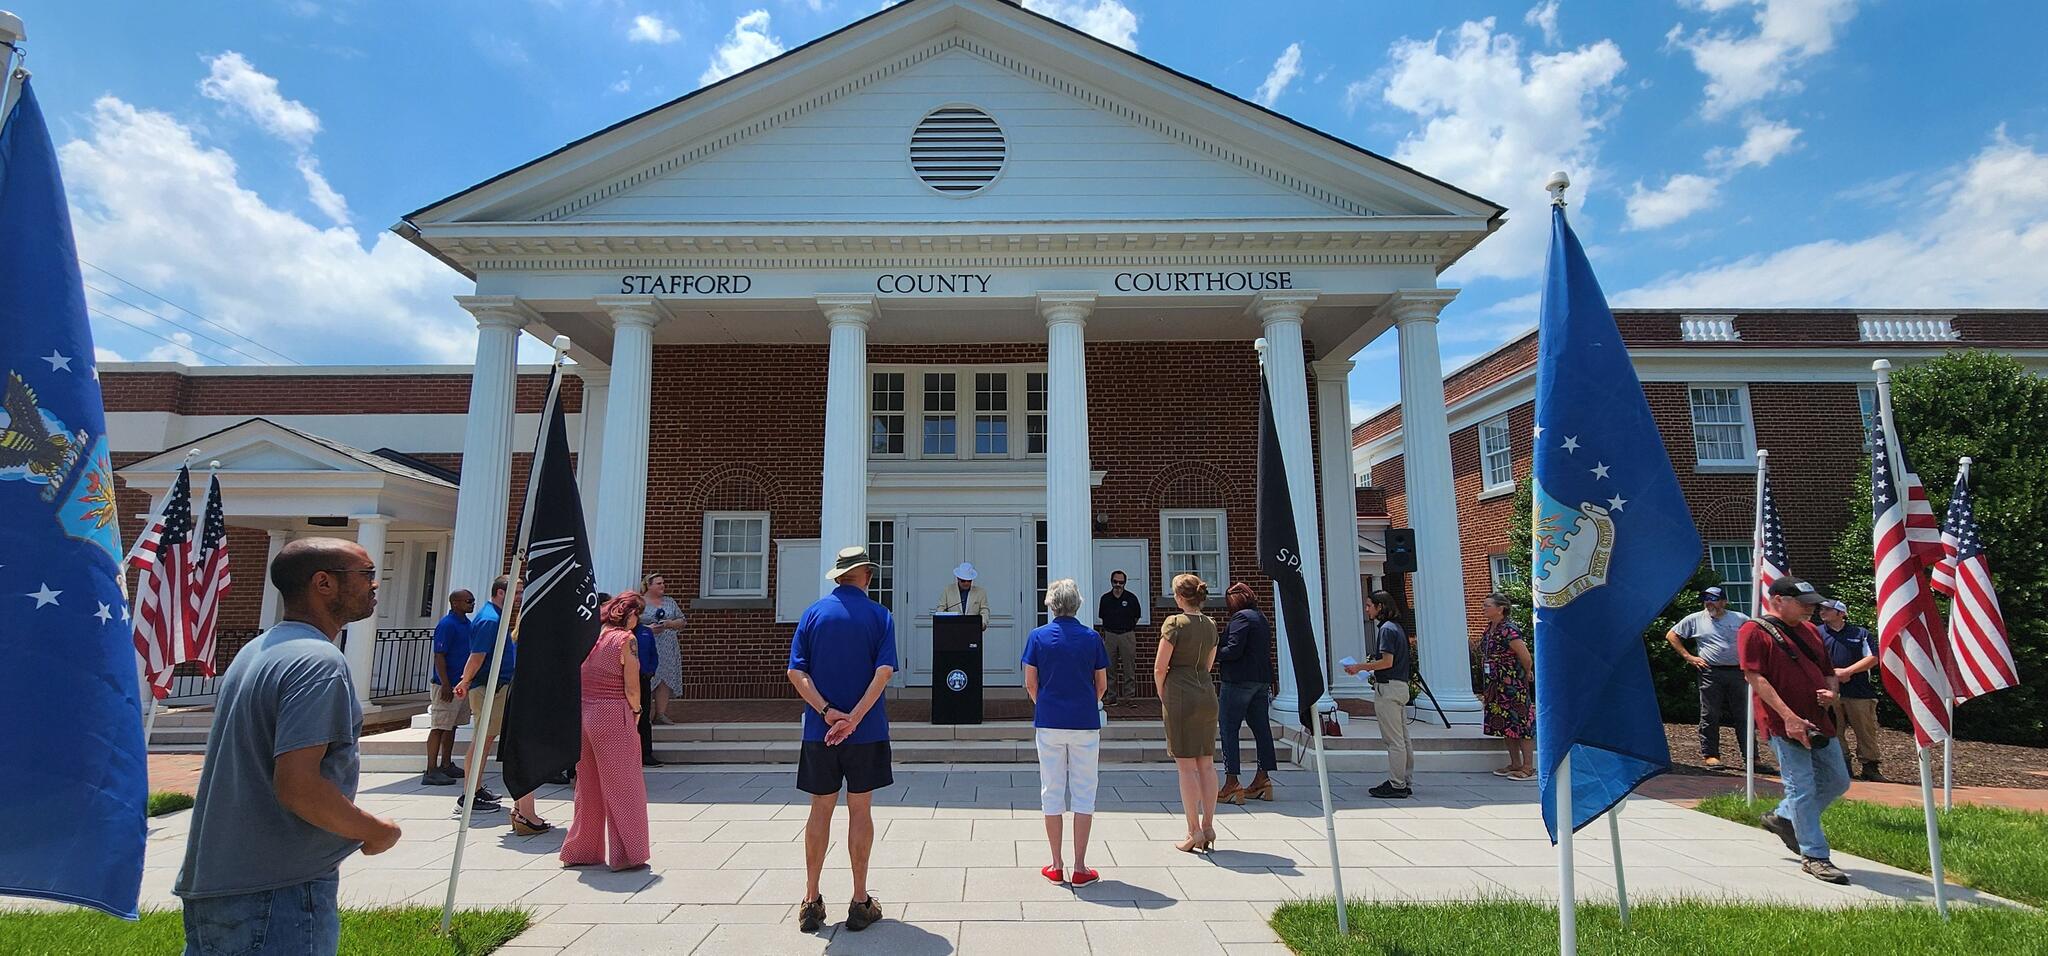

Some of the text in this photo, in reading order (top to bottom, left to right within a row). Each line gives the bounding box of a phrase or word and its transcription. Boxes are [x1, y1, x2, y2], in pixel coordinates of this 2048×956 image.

[620, 271, 1293, 295] STAFFORD COUNTY COURTHOUSE
